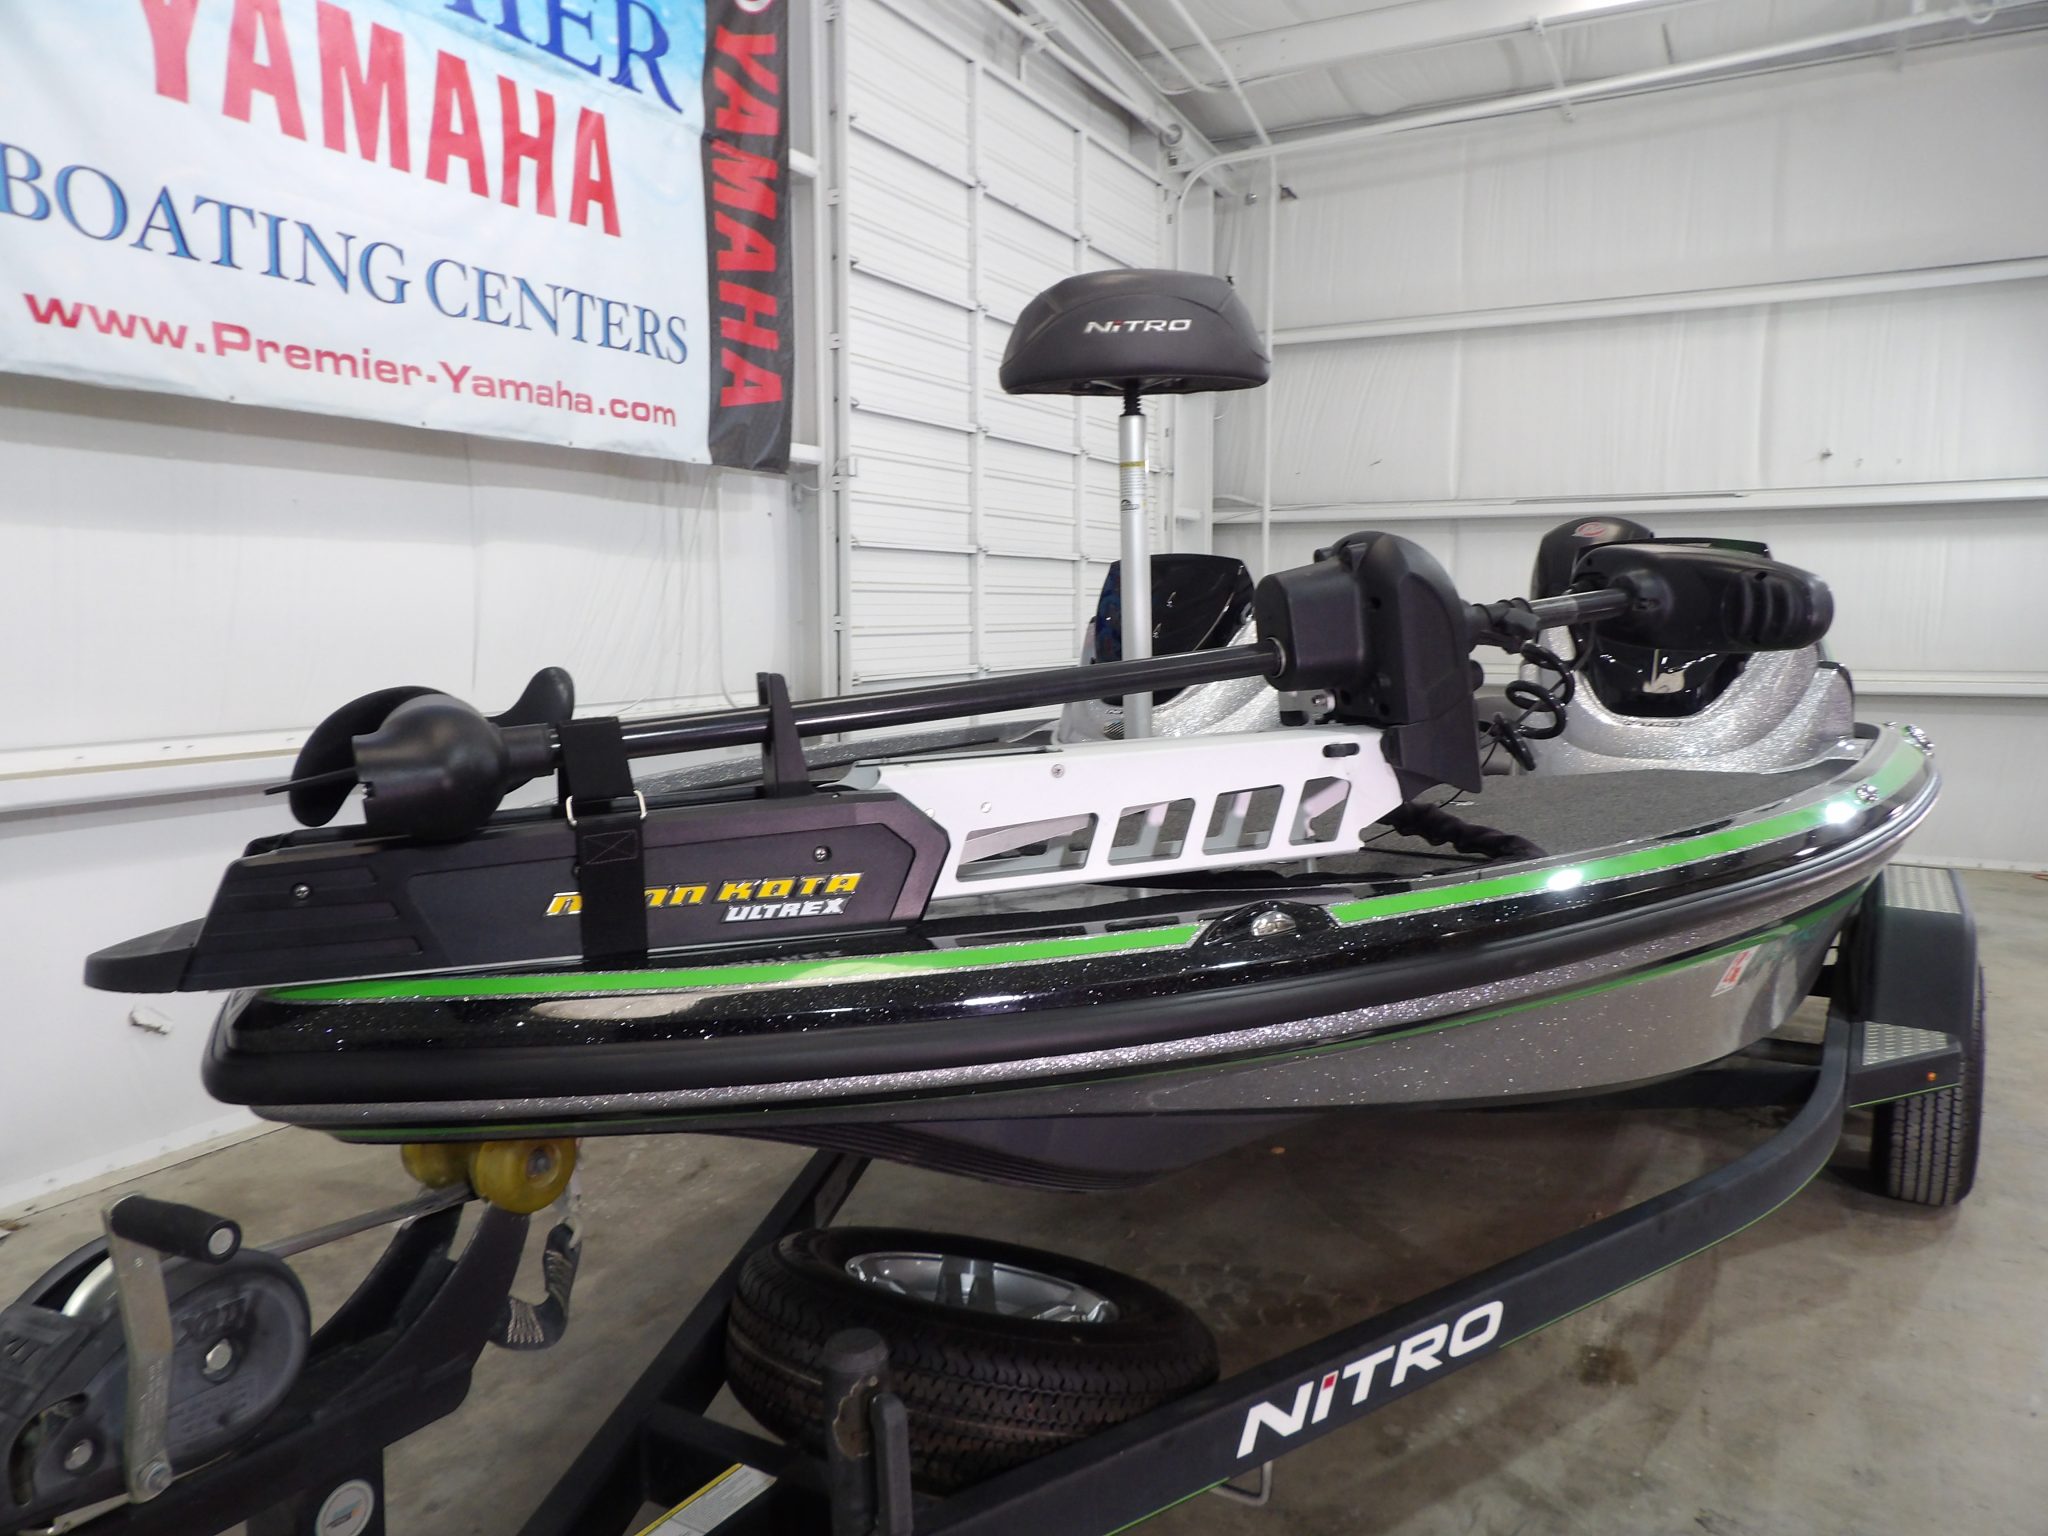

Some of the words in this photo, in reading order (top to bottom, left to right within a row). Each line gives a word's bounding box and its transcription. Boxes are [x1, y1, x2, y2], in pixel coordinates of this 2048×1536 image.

[141, 0, 622, 238] YAMAHA
[0, 142, 410, 305] BOATING
[425, 259, 689, 365] CENTERS
[712, 25, 782, 408] YAMAHA
[23, 293, 677, 427] www.Premier-Yamaha.com
[717, 873, 863, 902] KOTA
[725, 898, 846, 921] ULTREX
